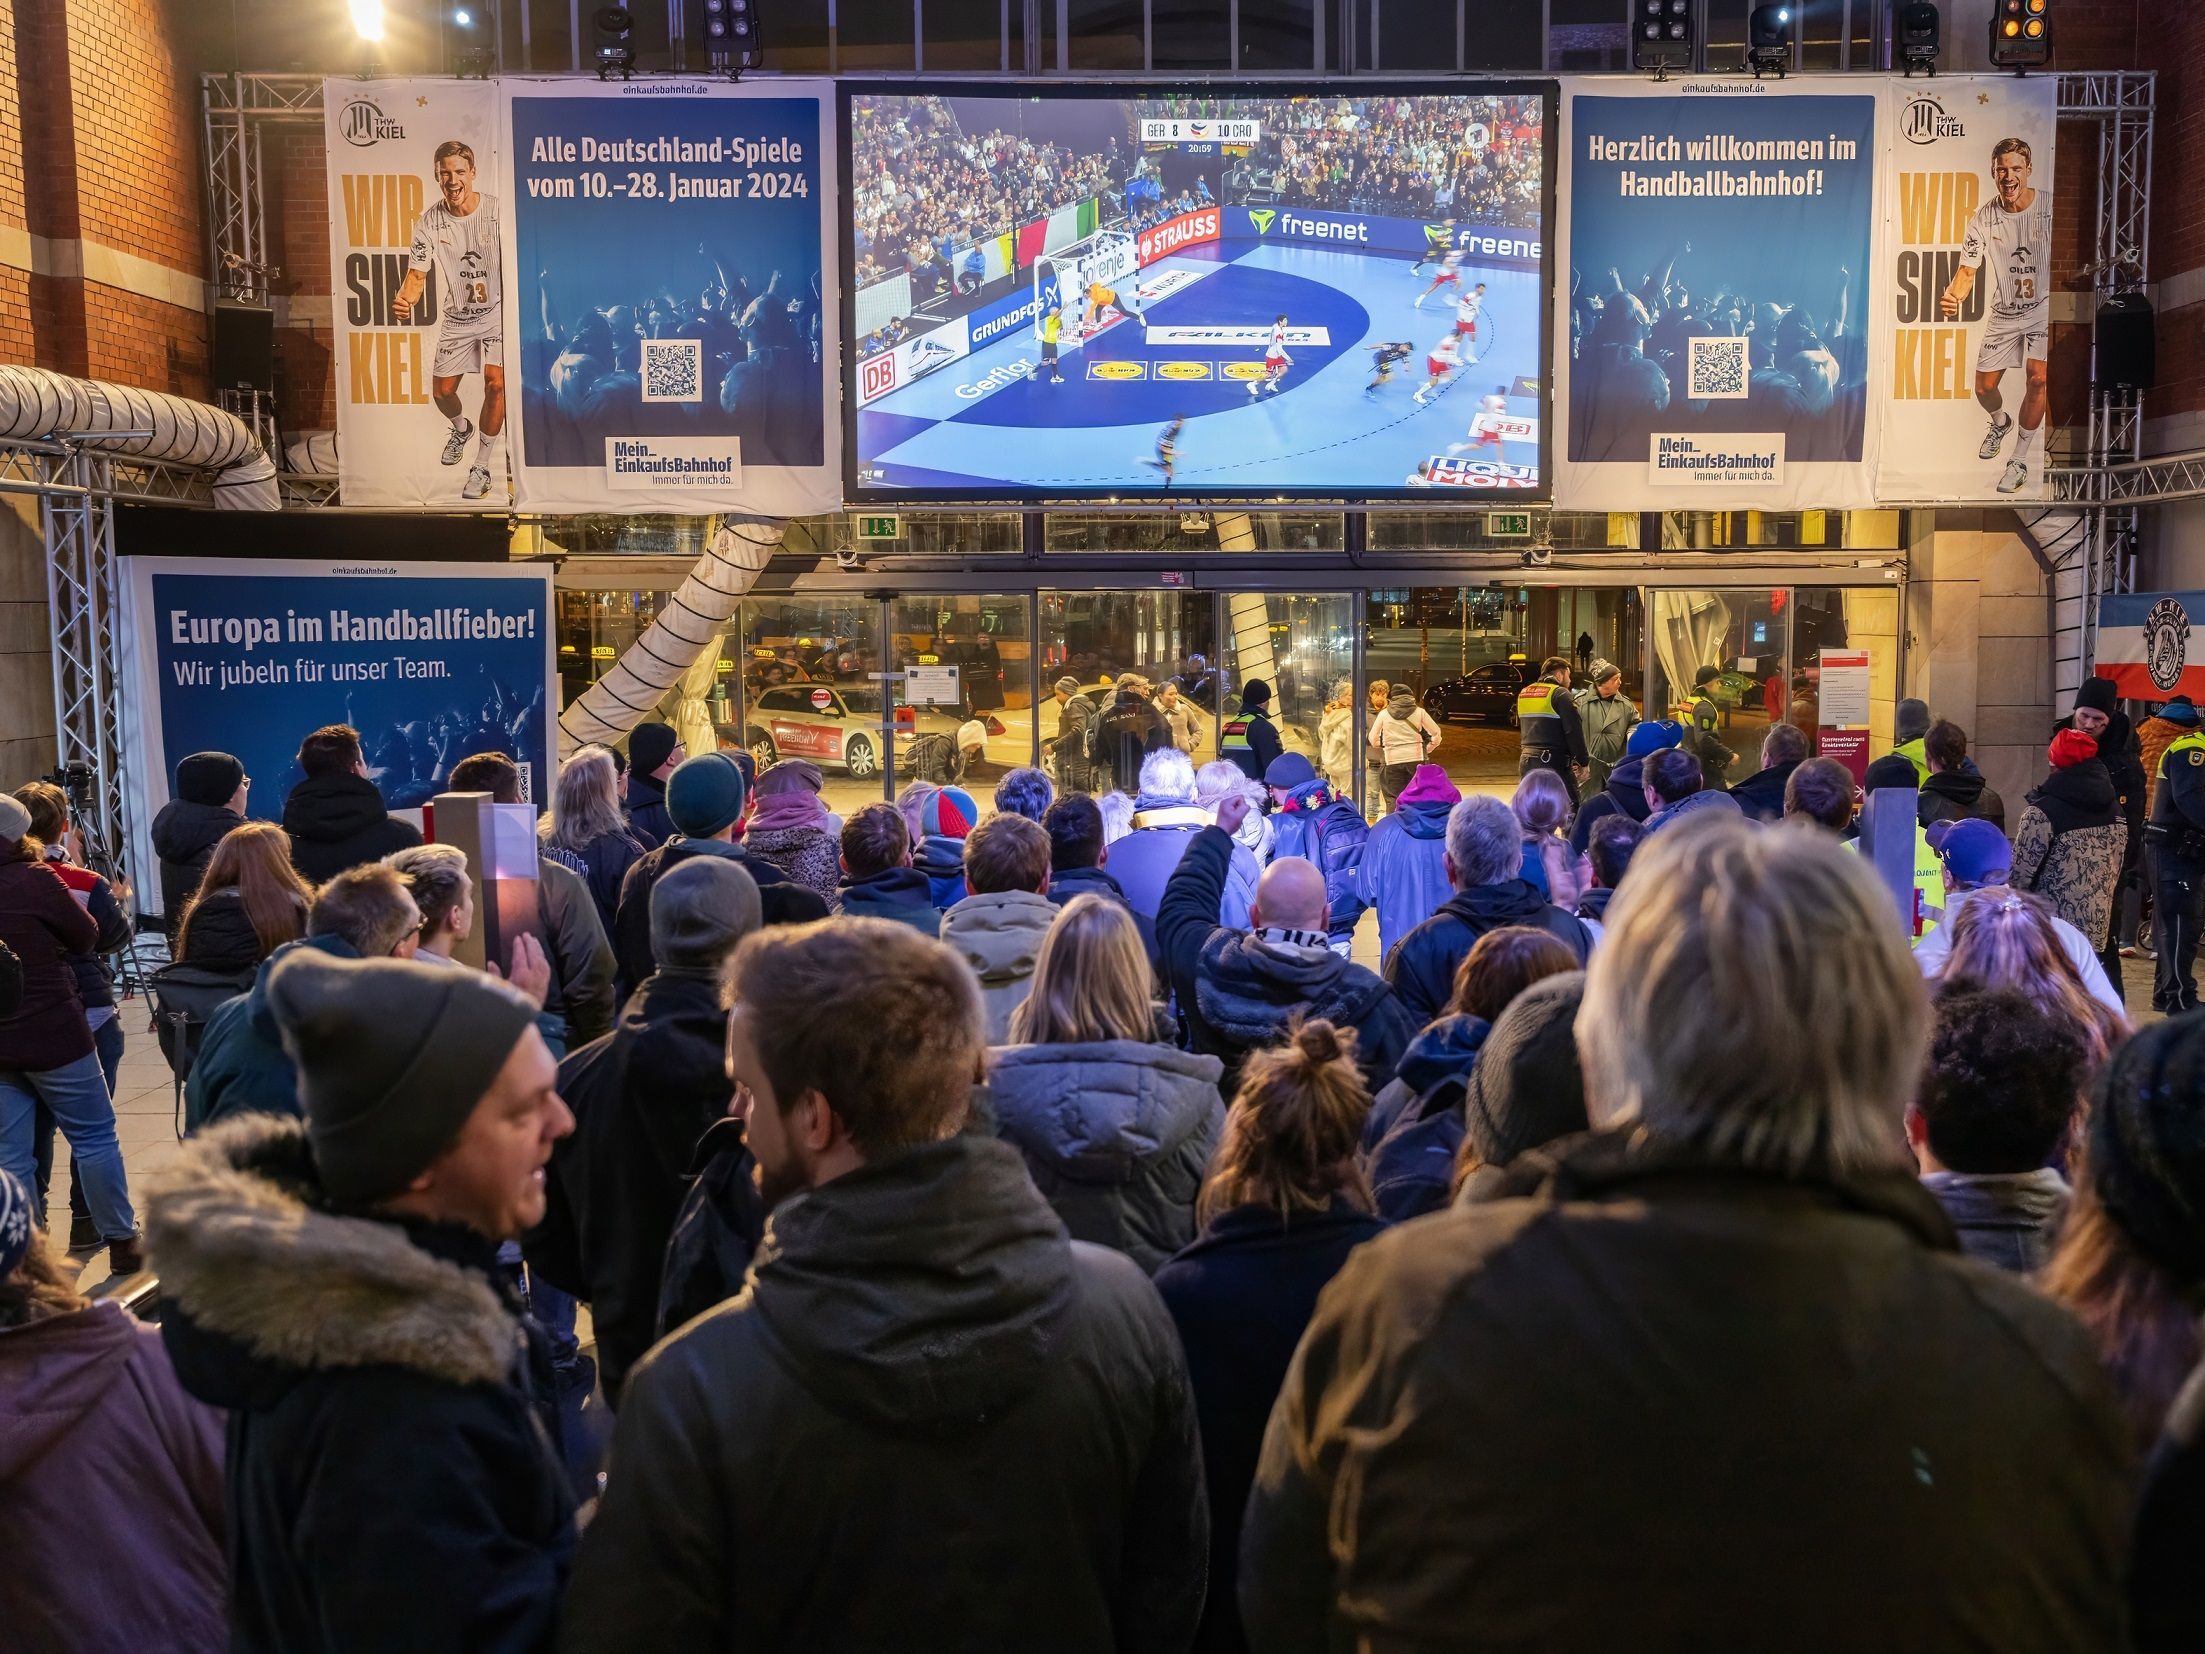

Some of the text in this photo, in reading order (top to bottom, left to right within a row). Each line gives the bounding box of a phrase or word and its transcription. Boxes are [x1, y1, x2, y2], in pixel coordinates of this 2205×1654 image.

[622, 84, 708, 95] einkaufsbahnhof.de
[1682, 83, 1765, 93] einkaufsbahnhof.de
[374, 118, 396, 126] THW
[376, 126, 406, 139] KIEL
[1147, 124, 1179, 138] GER 8
[1217, 124, 1252, 138] 10 CRO
[1936, 116, 1957, 124] THW
[1936, 124, 1966, 137] KIEL
[531, 135, 803, 169] Alle Deutschland-Spiele
[1588, 133, 1857, 162] Herzlich willkommen im
[527, 177, 576, 199] vom
[668, 173, 743, 203] Januar
[747, 172, 809, 199] 2024
[1619, 168, 1823, 197] Handballbahnhof!
[341, 173, 424, 248] WIR
[1899, 171, 1981, 246] WIR
[1153, 214, 1217, 254] STRAUSS
[1281, 213, 1369, 242] freenet
[345, 252, 438, 327] SIND
[465, 282, 488, 304] 23
[1896, 250, 1986, 324] SIND
[2014, 278, 2035, 300] 23
[971, 296, 1046, 343] GRUNDFOS
[349, 331, 430, 405] KIEL
[866, 359, 892, 394] DB
[954, 356, 1034, 399] Gerflor
[1893, 328, 1972, 401] KIEL
[614, 455, 732, 474] EinkaufsBahnhof
[1658, 452, 1776, 470] EinkaufsBahnhof
[1693, 470, 1775, 481] Immer für mich da.
[652, 474, 734, 485] Immer für mich da.
[170, 607, 536, 651] Europa im Handballfieber!
[173, 655, 452, 691] Wir jubeln für unser Team.
